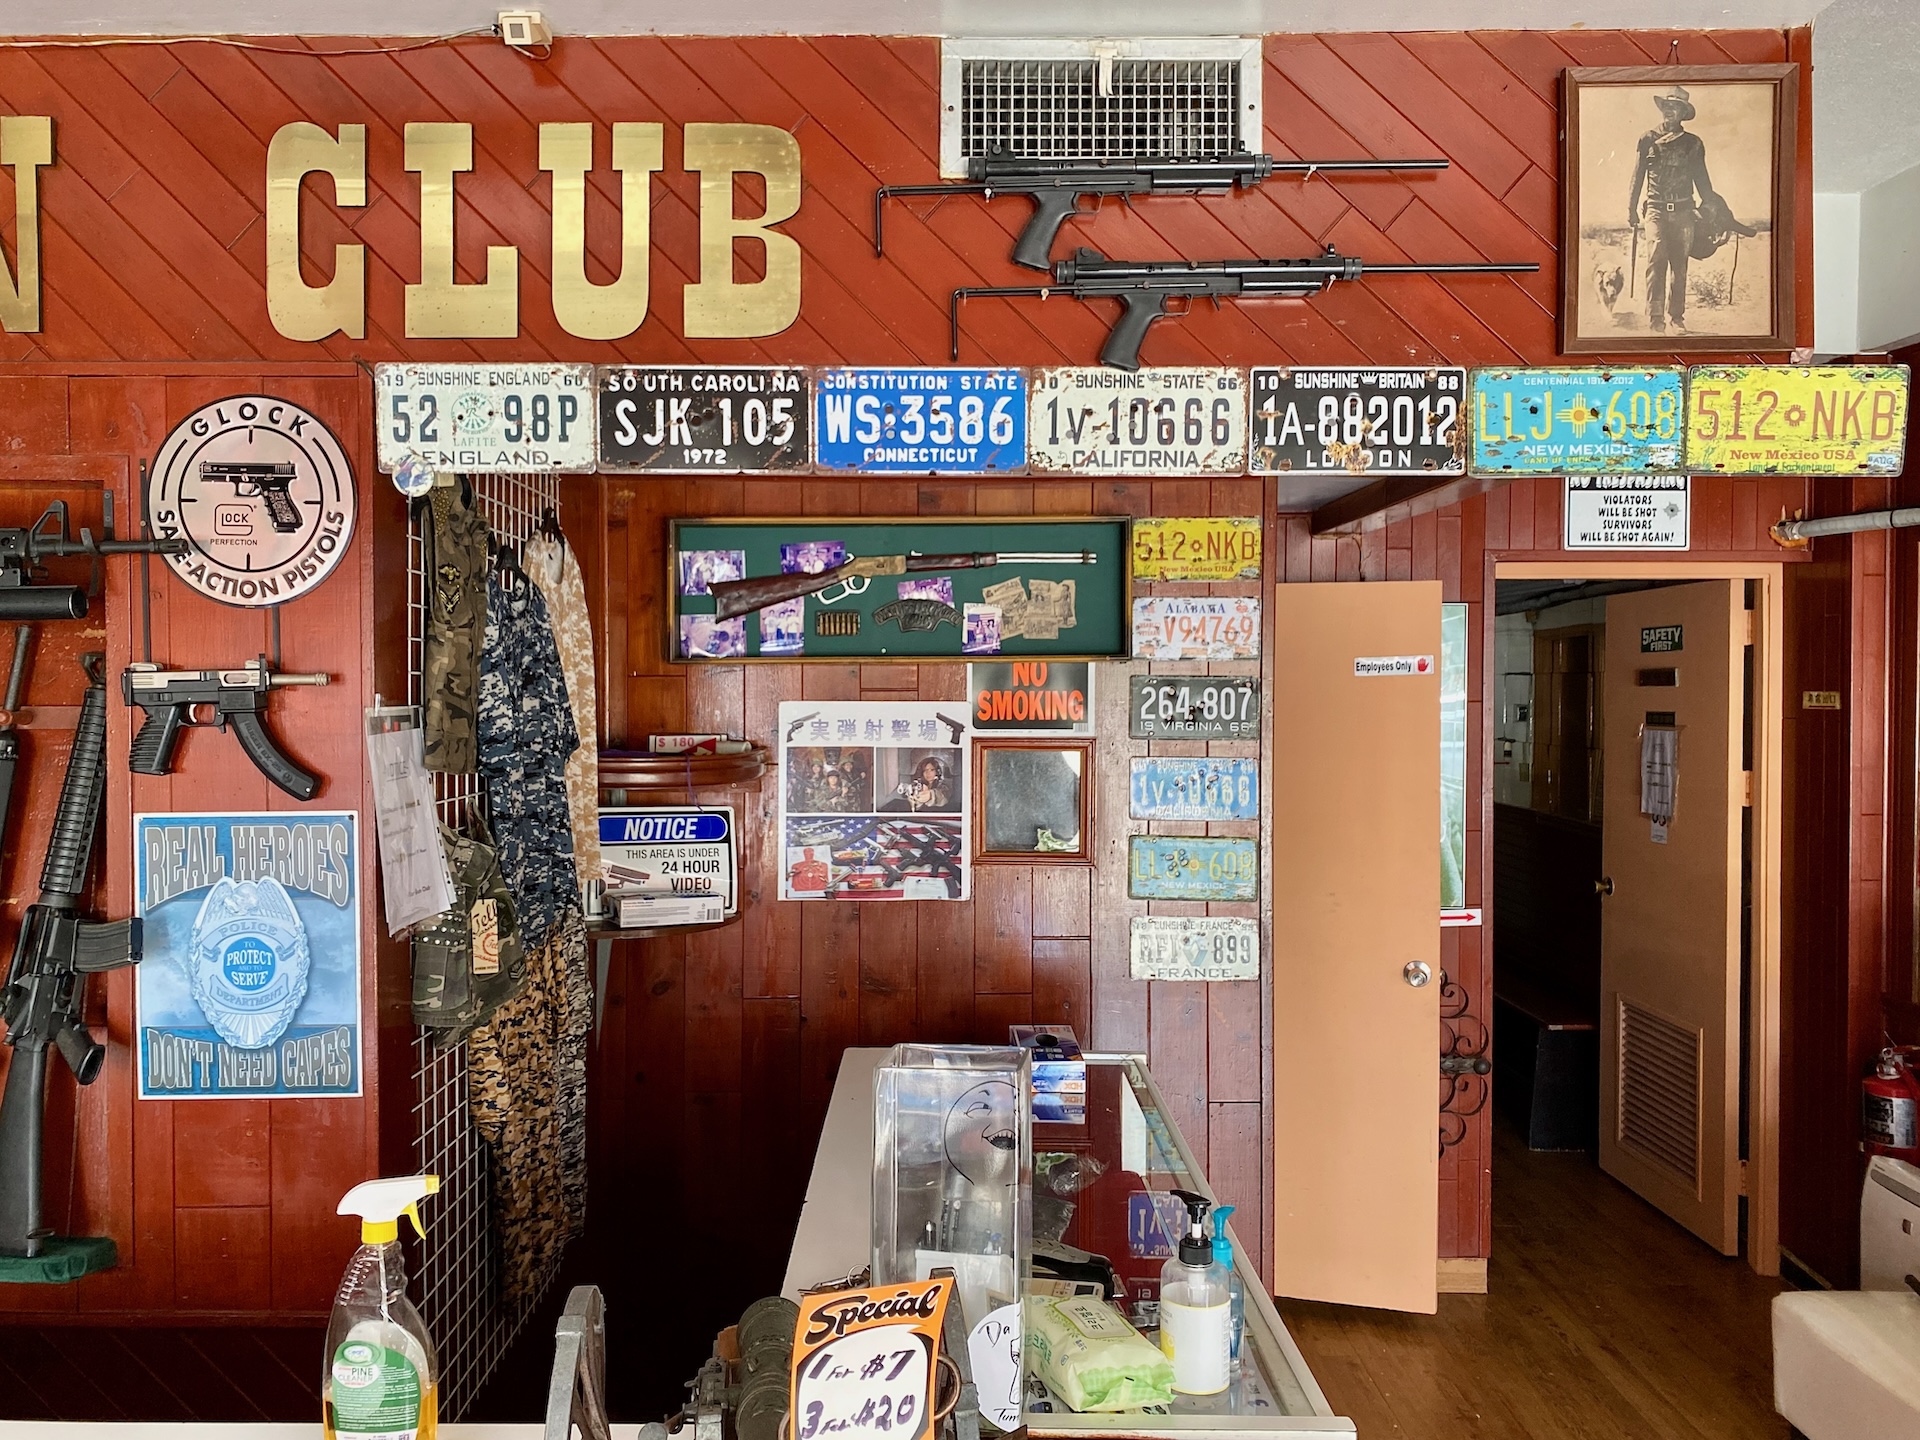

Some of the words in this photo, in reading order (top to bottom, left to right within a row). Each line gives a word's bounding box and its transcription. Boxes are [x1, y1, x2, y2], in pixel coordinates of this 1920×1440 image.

[266, 121, 801, 341] CLUB
[418, 372, 480, 386] SUNSHINE
[489, 372, 550, 386] ENGLAND
[824, 374, 948, 391] CONSTITUTION
[961, 374, 1018, 391] STATE
[1076, 374, 1145, 389] SUNSHINE
[1163, 374, 1204, 389] STATE
[1217, 377, 1238, 390] 66
[1258, 375, 1279, 391] 10
[1294, 372, 1360, 389] SUNSHINE
[1378, 372, 1426, 389] BRITAIN
[1437, 375, 1459, 391] 88
[1523, 377, 1585, 386] CENTENNIAL
[191, 402, 310, 437] GLOCK
[392, 394, 438, 443] 52
[504, 394, 578, 443] 98P
[614, 398, 693, 447] SJK
[719, 398, 795, 447] 105
[1479, 391, 1553, 442] LLJ
[1606, 390, 1676, 440] 608
[1697, 390, 1779, 441] 512
[1812, 390, 1896, 441] NKB
[453, 438, 496, 447] LAFITE
[1524, 444, 1564, 456] NEW
[1569, 444, 1634, 456] MEXICO
[421, 451, 549, 466] ENGLAND
[683, 449, 727, 465] 1972
[863, 448, 978, 463] CONNECTICUT
[1072, 450, 1200, 468] CALIFORNIA
[1729, 450, 1762, 460] New
[1765, 449, 1819, 460] Mexico
[1823, 449, 1856, 460] USA
[1603, 495, 1652, 505] VIOLATORS
[1598, 507, 1620, 517] WILL
[1623, 507, 1632, 517] BE
[1635, 507, 1657, 517] SHOT
[1603, 519, 1652, 530] SURVIVORS
[209, 538, 258, 546] PERFECTION
[1581, 532, 1602, 542] WILL
[1605, 532, 1614, 542] BE
[1617, 532, 1639, 542] SHOT
[1642, 532, 1674, 542] AGAIN!
[1207, 531, 1255, 560] NKB
[158, 510, 280, 600] SAE-ACTION
[282, 510, 345, 590] PISTOLS
[1165, 603, 1226, 614] ALABAMA
[1164, 615, 1254, 645] V94769
[1642, 627, 1681, 646] SAFETY
[1650, 641, 1672, 651] FIRST
[1012, 662, 1047, 687] NO
[1356, 662, 1394, 674] Employees
[1396, 661, 1412, 673] Only
[977, 689, 1084, 722] SMOKING
[1140, 721, 1154, 731] 19
[1162, 721, 1223, 731] VIRGINIA
[623, 817, 698, 841] NOTICE
[626, 849, 647, 859] THIS
[649, 848, 675, 859] AREA
[677, 848, 686, 858] IS
[688, 847, 720, 858] UNDER
[144, 825, 226, 912] REAL
[231, 823, 349, 907] HEROES
[661, 861, 678, 874] 24
[683, 860, 720, 873] HOUR
[1209, 850, 1252, 880] 608
[670, 877, 712, 891] VIDEO
[1187, 882, 1227, 890] MEXICO
[218, 921, 278, 938] POLICE
[1200, 921, 1234, 931] FRANCE
[243, 941, 256, 949] TO
[1213, 935, 1252, 964] 899
[226, 949, 272, 967] PROTECT
[231, 970, 269, 986] SERVE
[1157, 968, 1233, 978] FRANCE
[216, 985, 283, 1007] DEPARTMENT
[147, 1027, 213, 1089] DON'T
[217, 1046, 277, 1088] NEED
[282, 1026, 352, 1088] CAPES
[804, 1284, 943, 1345] Special
[351, 1367, 373, 1377] PINE
[808, 1354, 832, 1380] 1
[801, 1400, 824, 1439] 3
